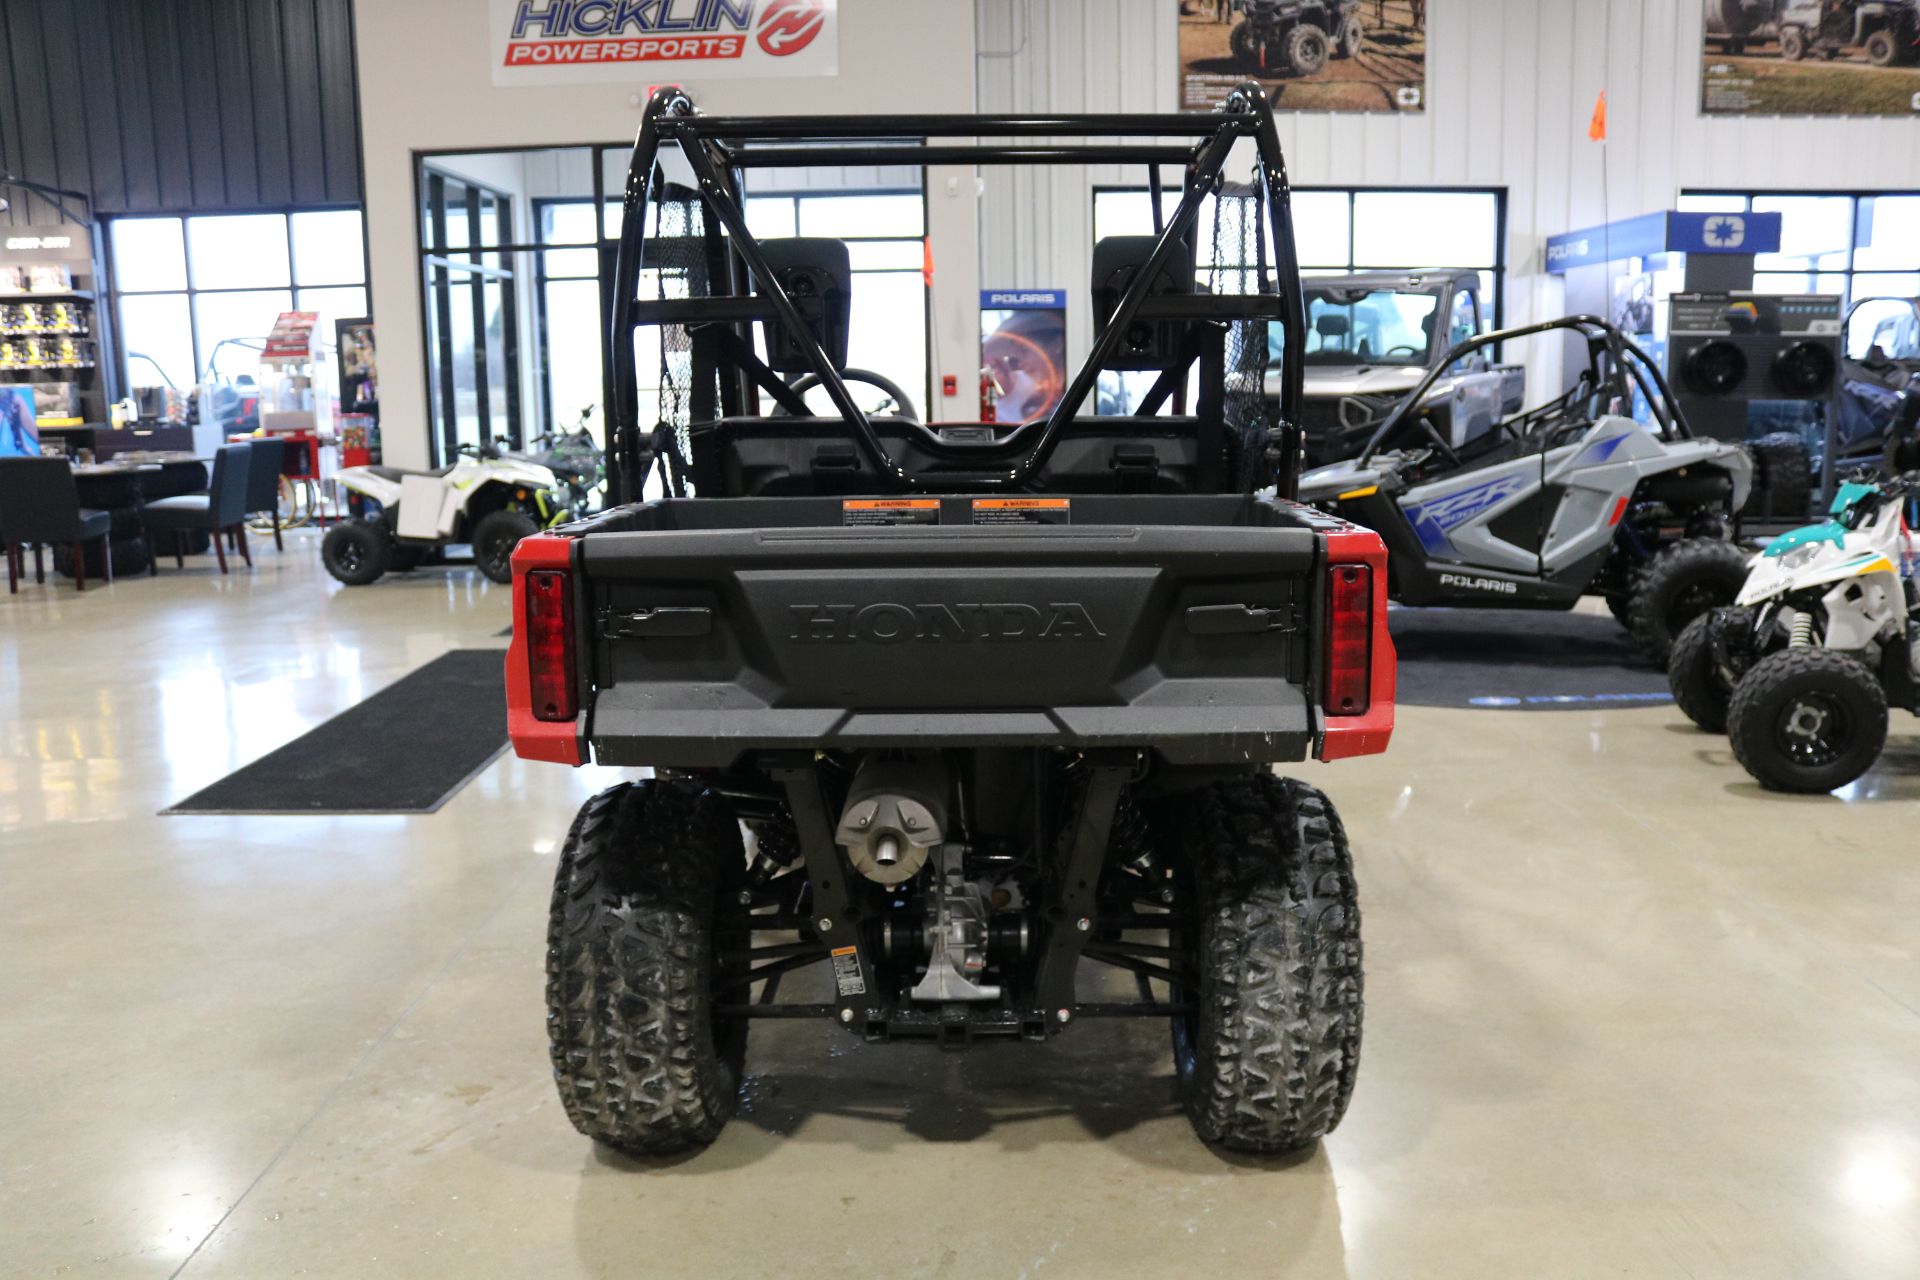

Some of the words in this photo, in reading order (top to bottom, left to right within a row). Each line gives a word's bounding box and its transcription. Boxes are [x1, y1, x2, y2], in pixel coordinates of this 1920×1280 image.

[510, 0, 756, 38] HICKLIN
[511, 37, 738, 62] POWERSPORTS
[991, 293, 1055, 304] POLARIS
[1440, 573, 1517, 594] POLARIS
[789, 602, 1107, 644] HONDA
